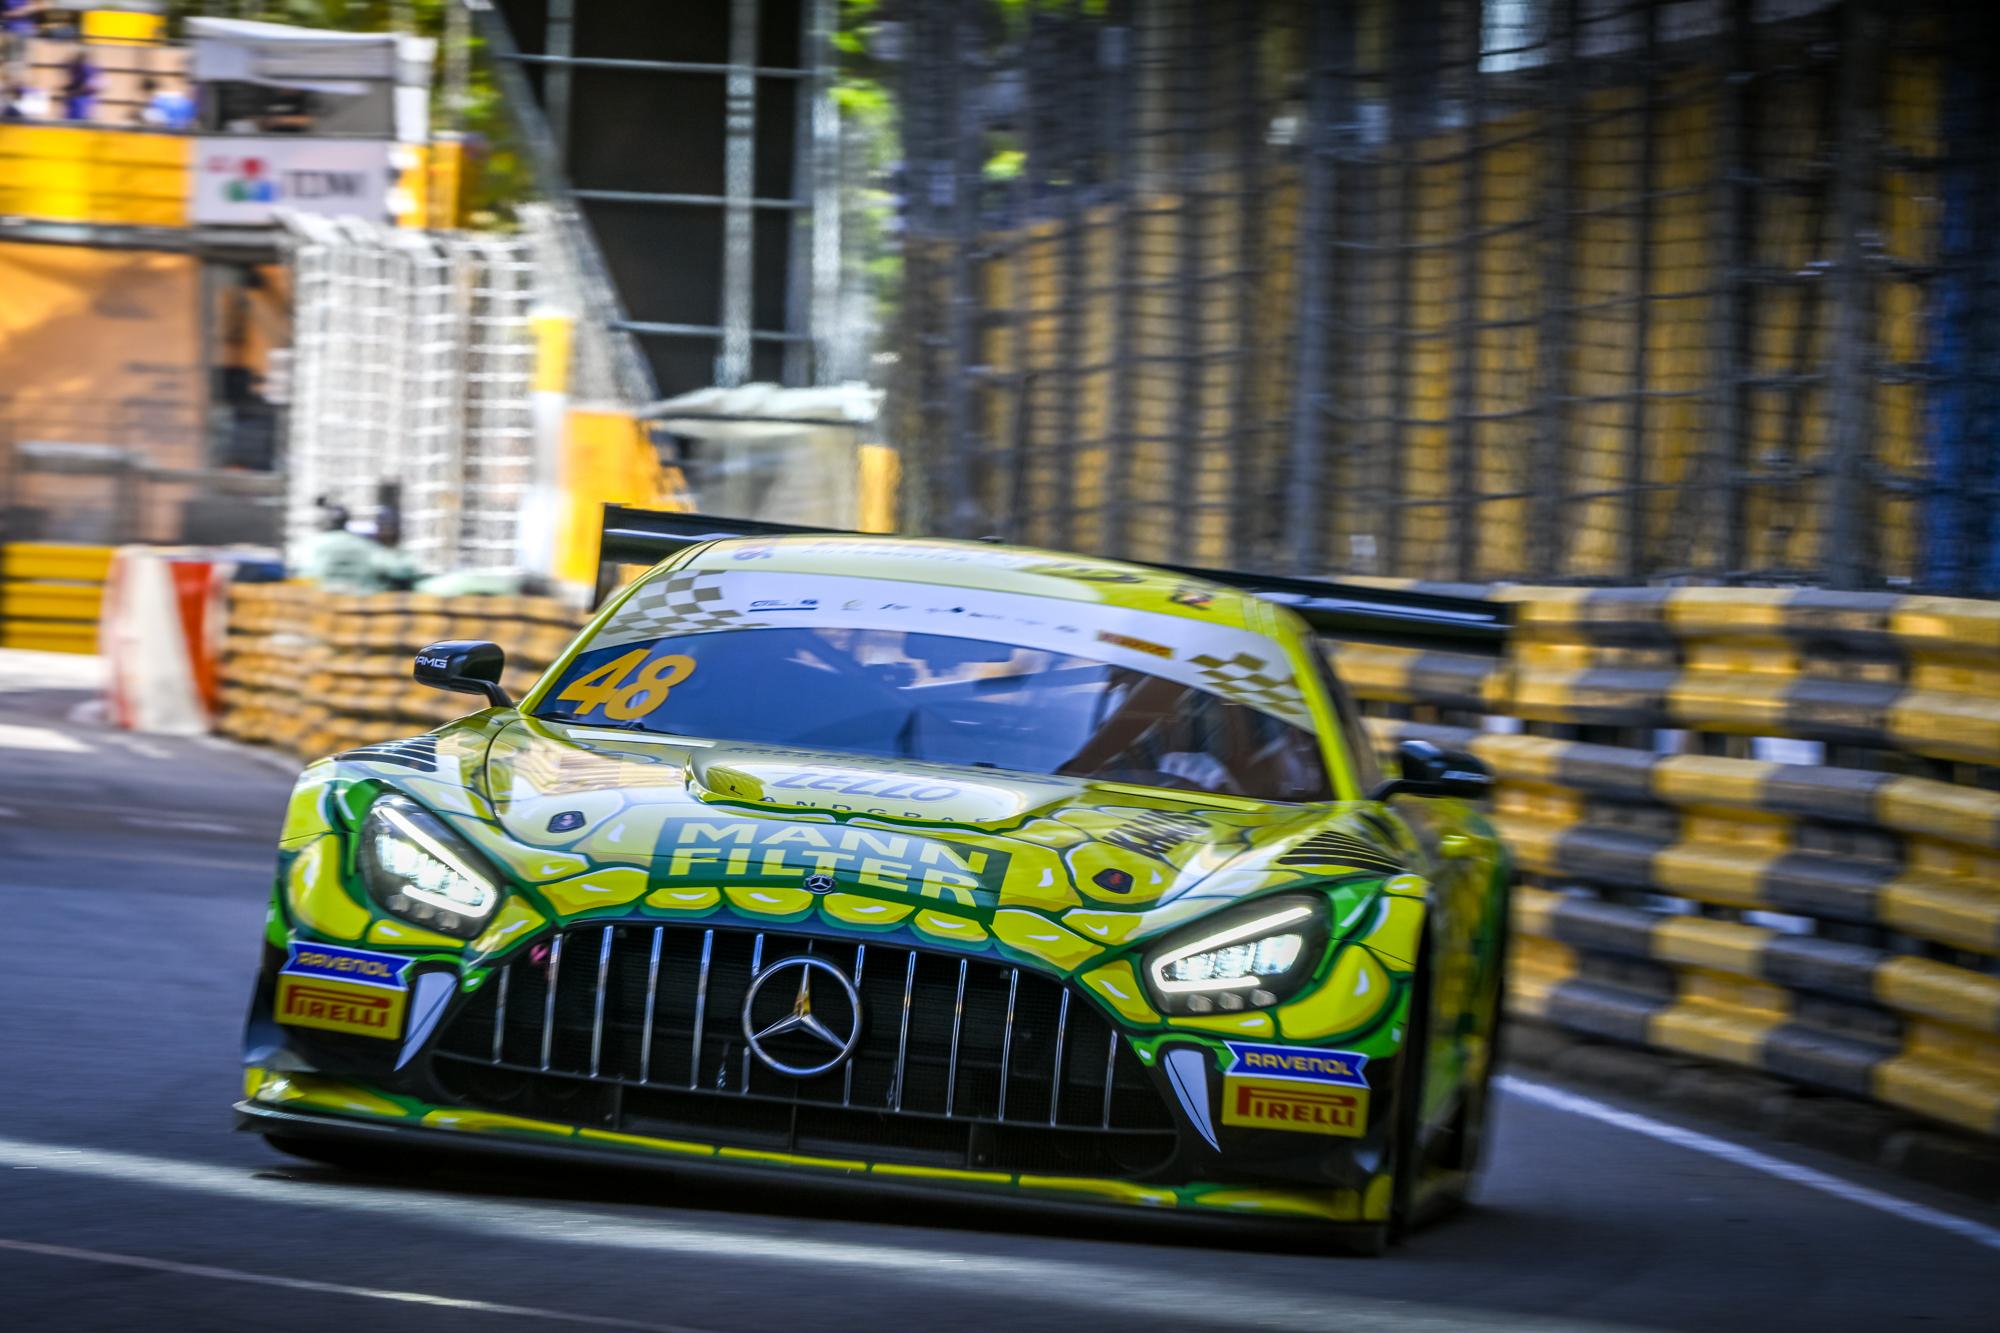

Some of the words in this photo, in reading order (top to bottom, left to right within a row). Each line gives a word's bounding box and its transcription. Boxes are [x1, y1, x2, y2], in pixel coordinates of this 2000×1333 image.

[416, 656, 448, 669] AMG
[557, 648, 697, 720] 48
[677, 822, 989, 874] MANN
[668, 847, 979, 908] FILTER
[297, 951, 392, 978] RAVENOL
[283, 984, 392, 1028] PIRELLI
[1244, 1052, 1354, 1076] RAVENOL
[1236, 1085, 1357, 1128] PIRELLI
